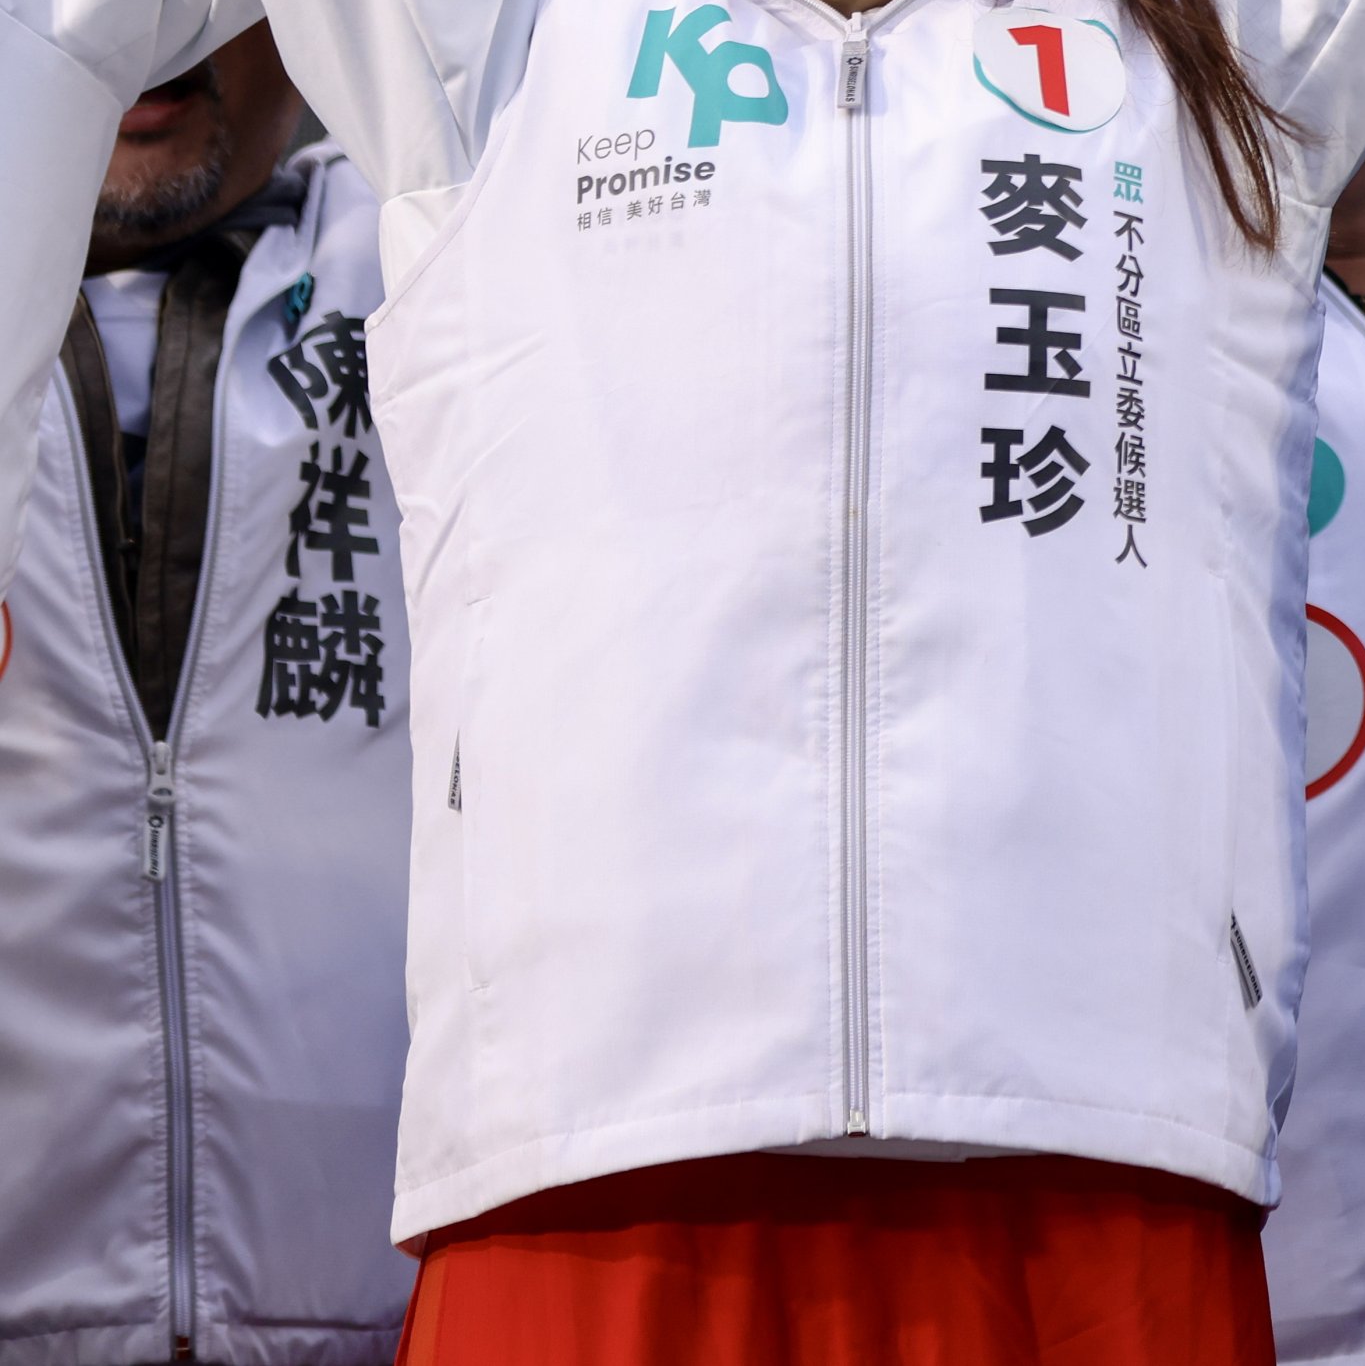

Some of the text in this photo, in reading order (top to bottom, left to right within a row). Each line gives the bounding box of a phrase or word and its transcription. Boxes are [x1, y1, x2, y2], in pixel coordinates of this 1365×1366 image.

[1005, 24, 1071, 118] 1
[577, 129, 656, 165] Keep
[577, 155, 717, 205] Promise
[577, 189, 713, 232] 相信 美好台灣
[978, 152, 1092, 539] 麥玉珍
[256, 310, 386, 729] 陳祥麟
